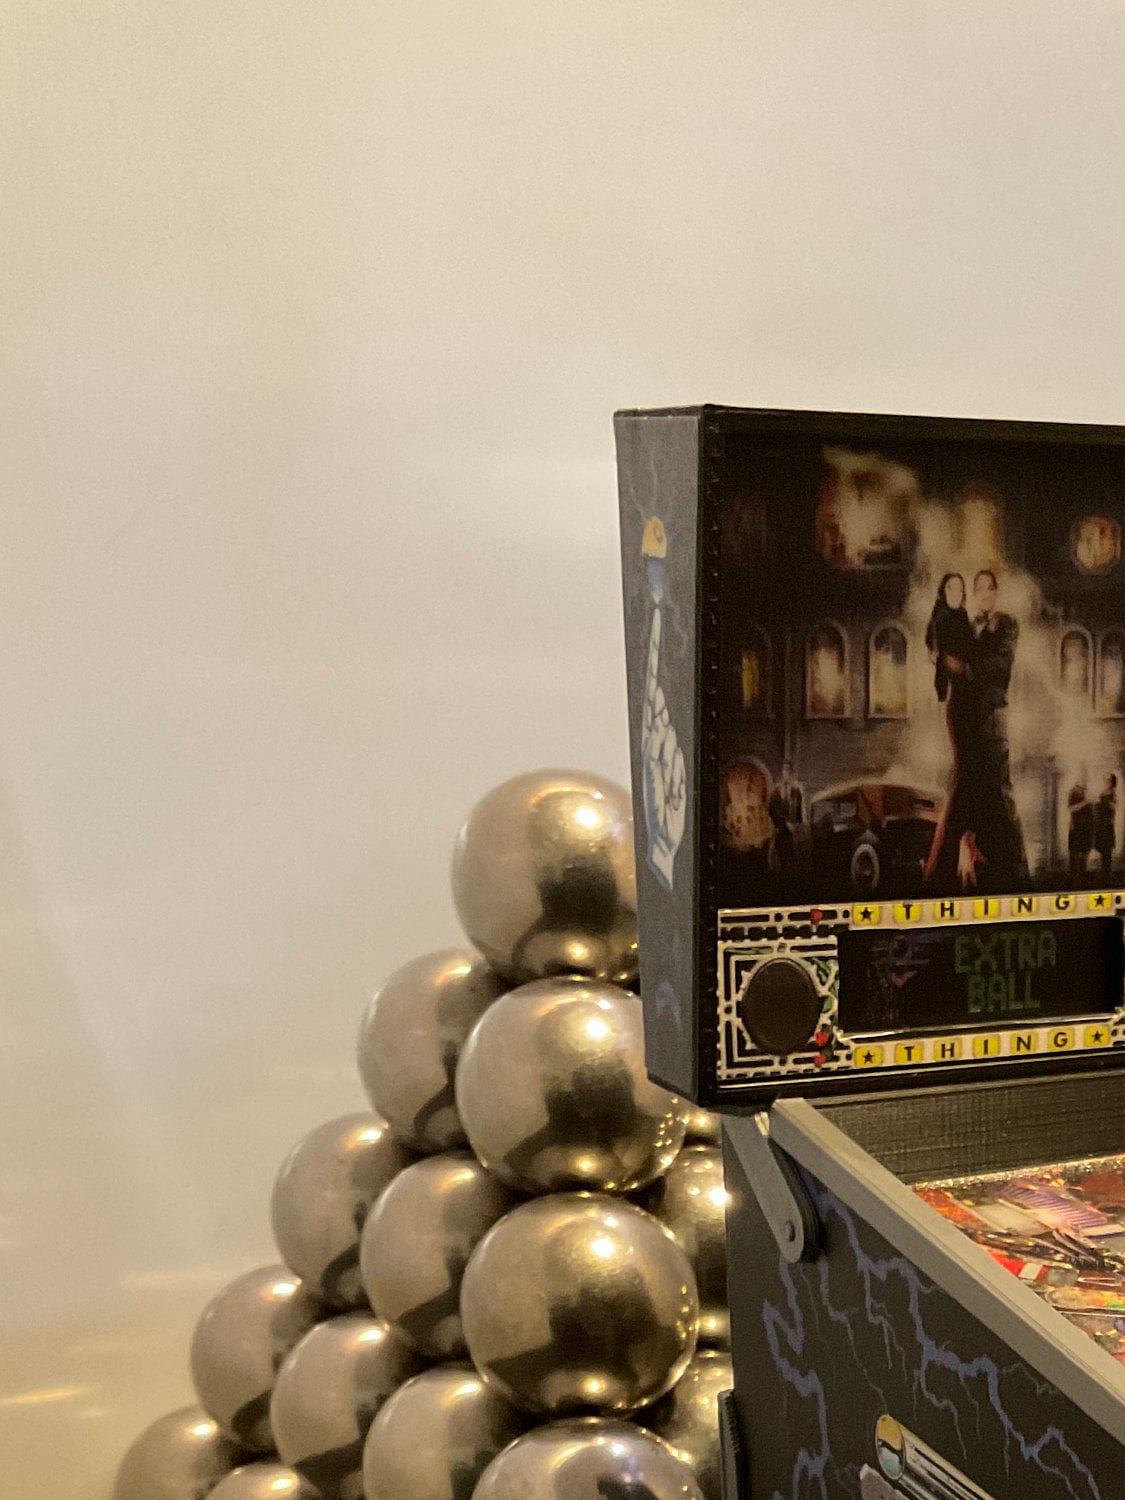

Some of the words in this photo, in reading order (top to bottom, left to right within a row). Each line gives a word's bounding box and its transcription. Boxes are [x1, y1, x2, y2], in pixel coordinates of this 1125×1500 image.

[902, 894, 1070, 920] THING
[954, 929, 1057, 974] EXTRA
[967, 971, 1041, 1014] BALL
[903, 1031, 1068, 1061] THING
